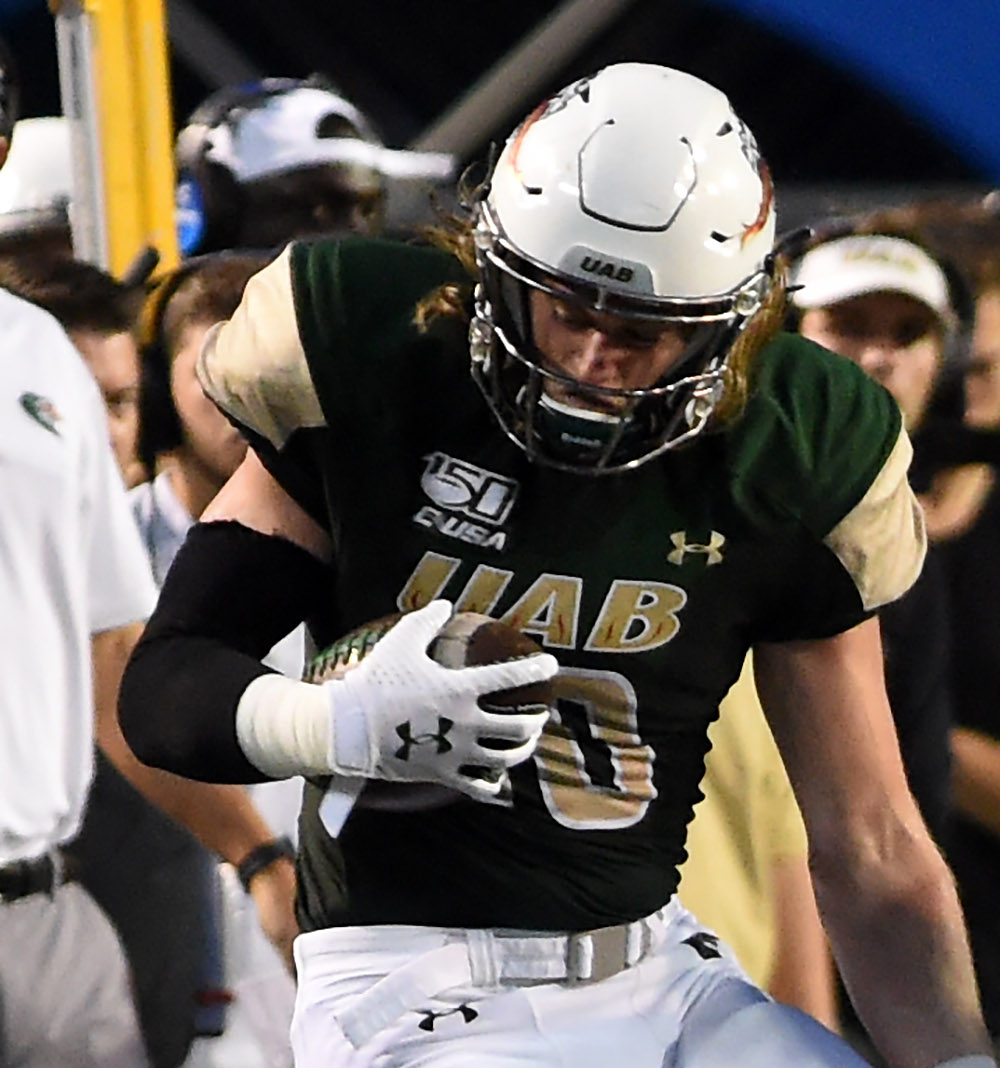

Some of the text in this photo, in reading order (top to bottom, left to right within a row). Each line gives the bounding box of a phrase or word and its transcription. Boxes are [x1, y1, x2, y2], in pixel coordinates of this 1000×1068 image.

[580, 256, 634, 283] UAB
[397, 551, 687, 651] UAB
[532, 664, 658, 830] 0
